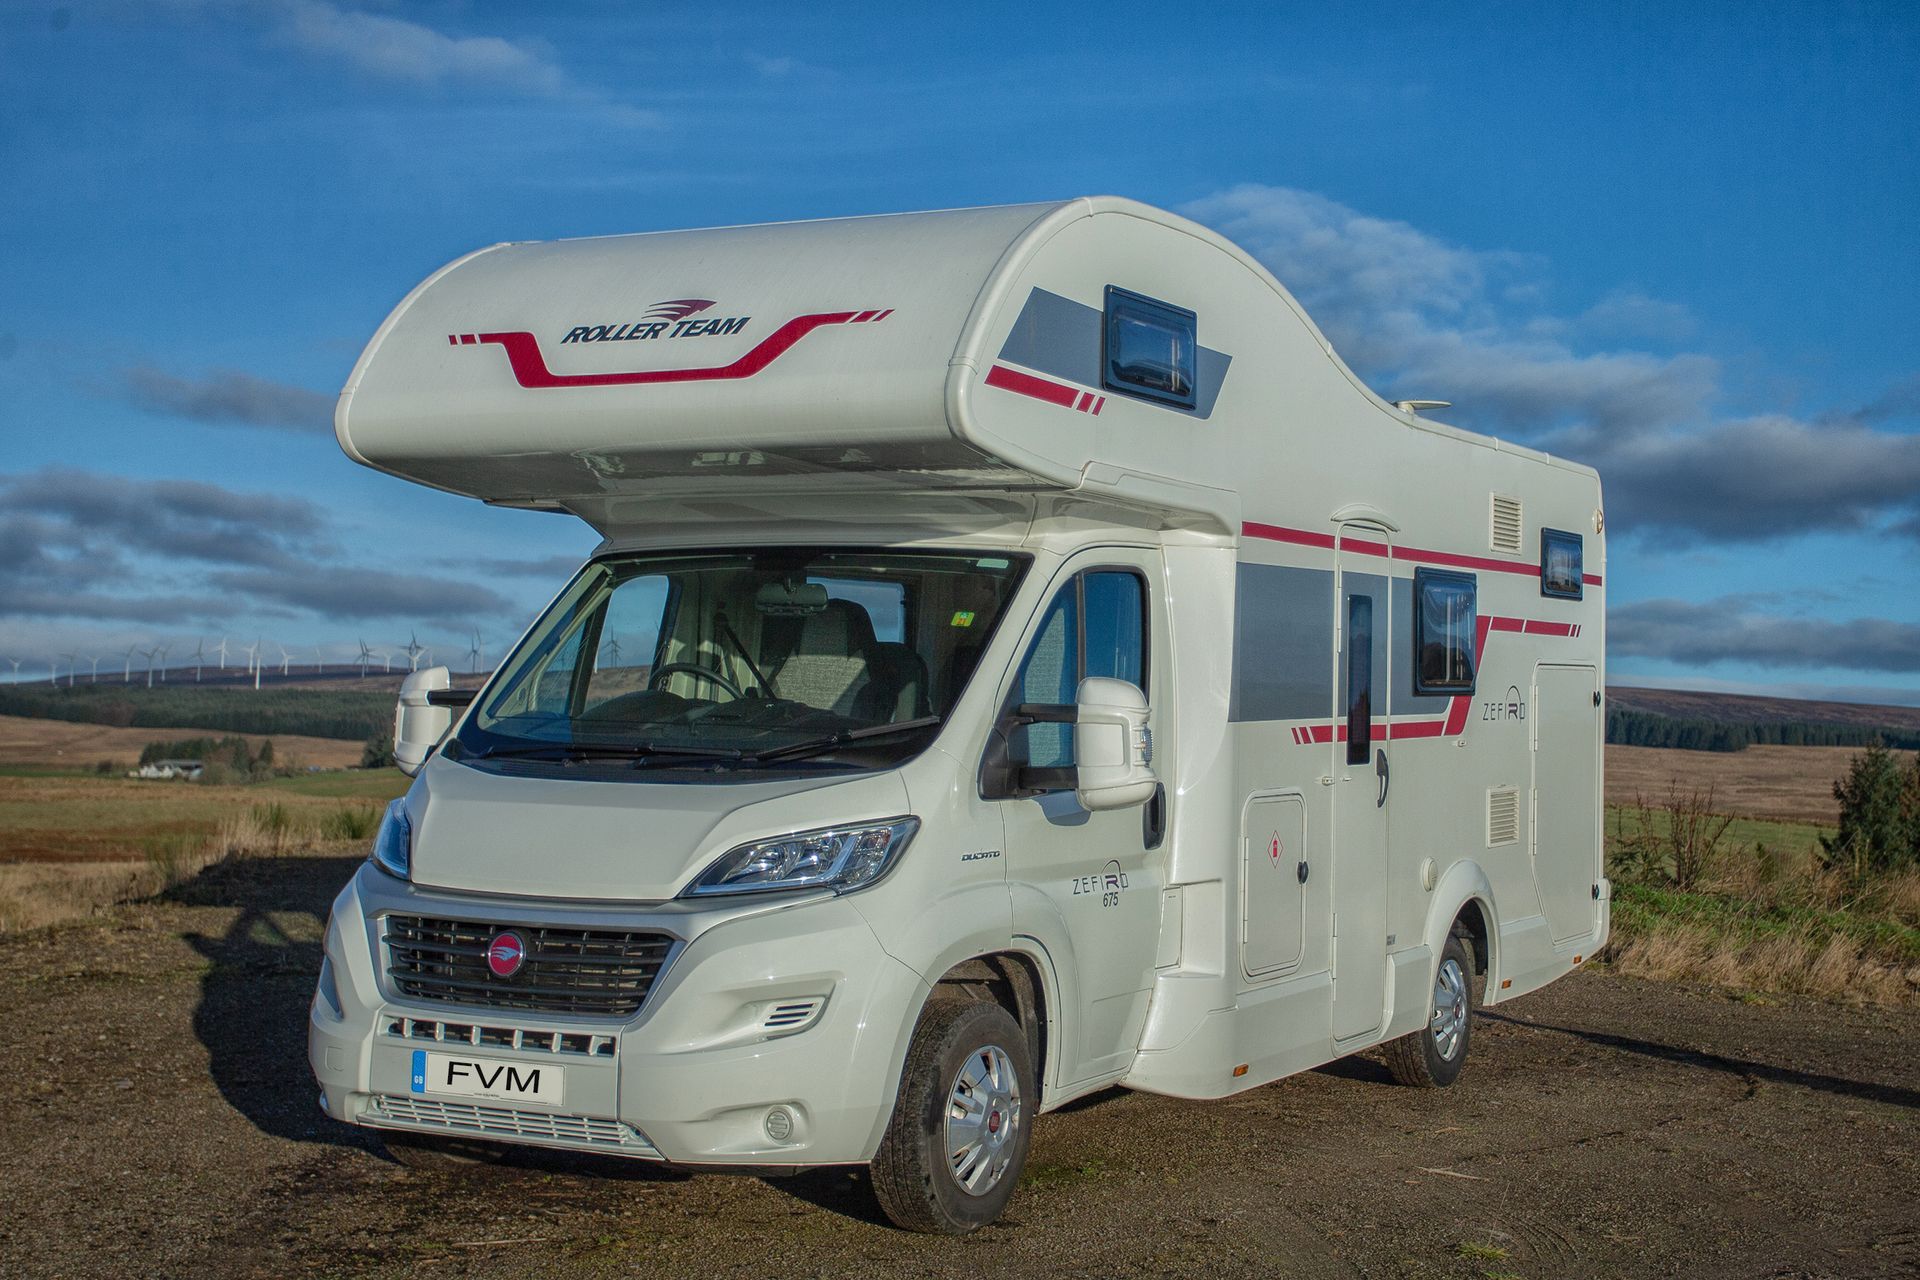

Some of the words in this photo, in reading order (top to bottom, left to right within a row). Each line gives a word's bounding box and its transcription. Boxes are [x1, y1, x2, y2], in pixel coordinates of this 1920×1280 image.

[560, 322, 670, 344] ROLLER
[669, 316, 752, 339] TEAM
[961, 850, 1000, 861] DUCATO
[1072, 859, 1128, 894] ZEFIRO
[1103, 891, 1119, 907] 675
[414, 1075, 424, 1085] GB
[447, 1060, 541, 1094] FVM
